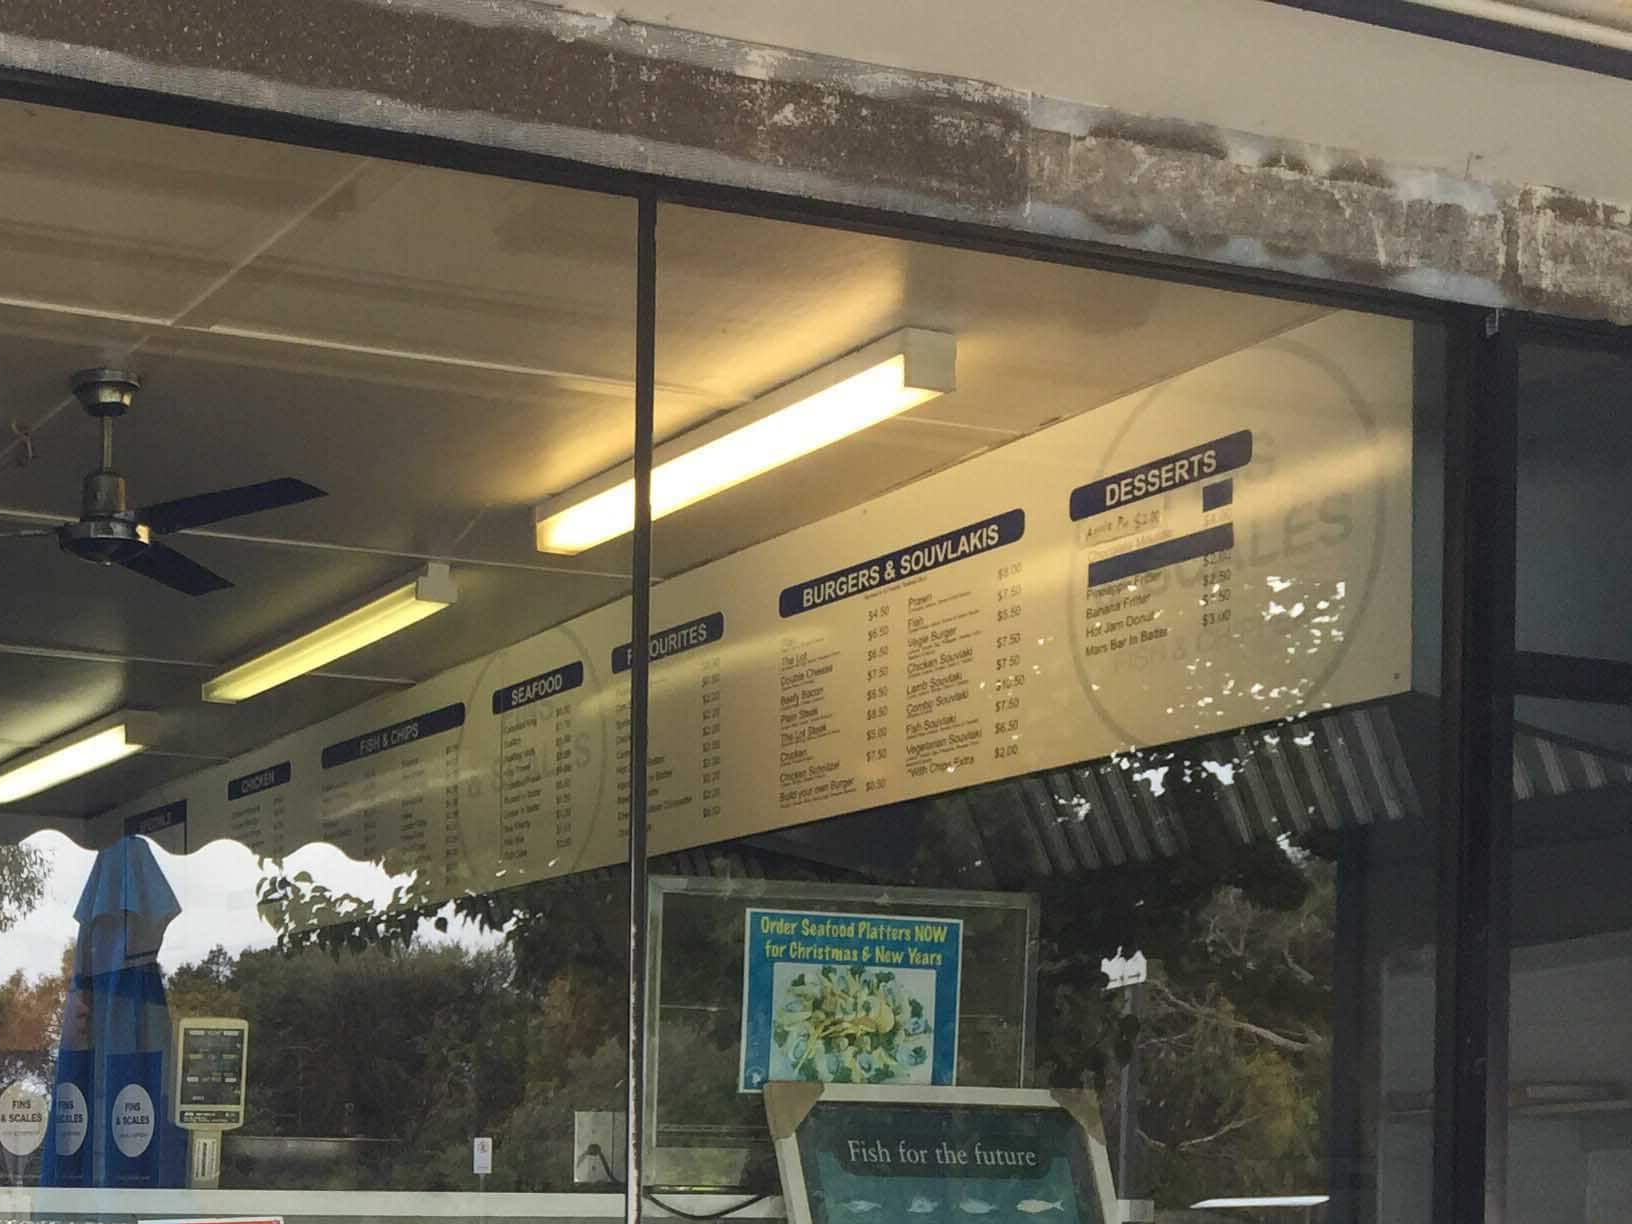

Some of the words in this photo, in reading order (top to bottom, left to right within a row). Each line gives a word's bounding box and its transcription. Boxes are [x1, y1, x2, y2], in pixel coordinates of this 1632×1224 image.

[1105, 449, 1218, 507] DESSERTS
[802, 564, 881, 608] BURGERS
[884, 560, 896, 578] &
[900, 523, 1000, 576] SOUVLAKIS
[626, 623, 708, 666] FOURITES
[1085, 643, 1108, 657] Mars
[1110, 637, 1127, 651] Bar
[511, 673, 563, 706] SEAFOOD
[391, 722, 419, 745] CHIPS
[761, 915, 798, 937] Order
[801, 918, 855, 939] Seafood
[857, 921, 912, 942] Platters
[914, 923, 948, 944] NOW
[765, 940, 786, 959] for
[789, 940, 858, 963] Christmas
[862, 946, 873, 964] &
[875, 946, 904, 965] New
[907, 947, 944, 967] Years
[8, 1112, 43, 1123] SCALES
[848, 1139, 890, 1163] Fish
[899, 1139, 928, 1165] for
[935, 1141, 967, 1165] the
[973, 1144, 1039, 1167] future
